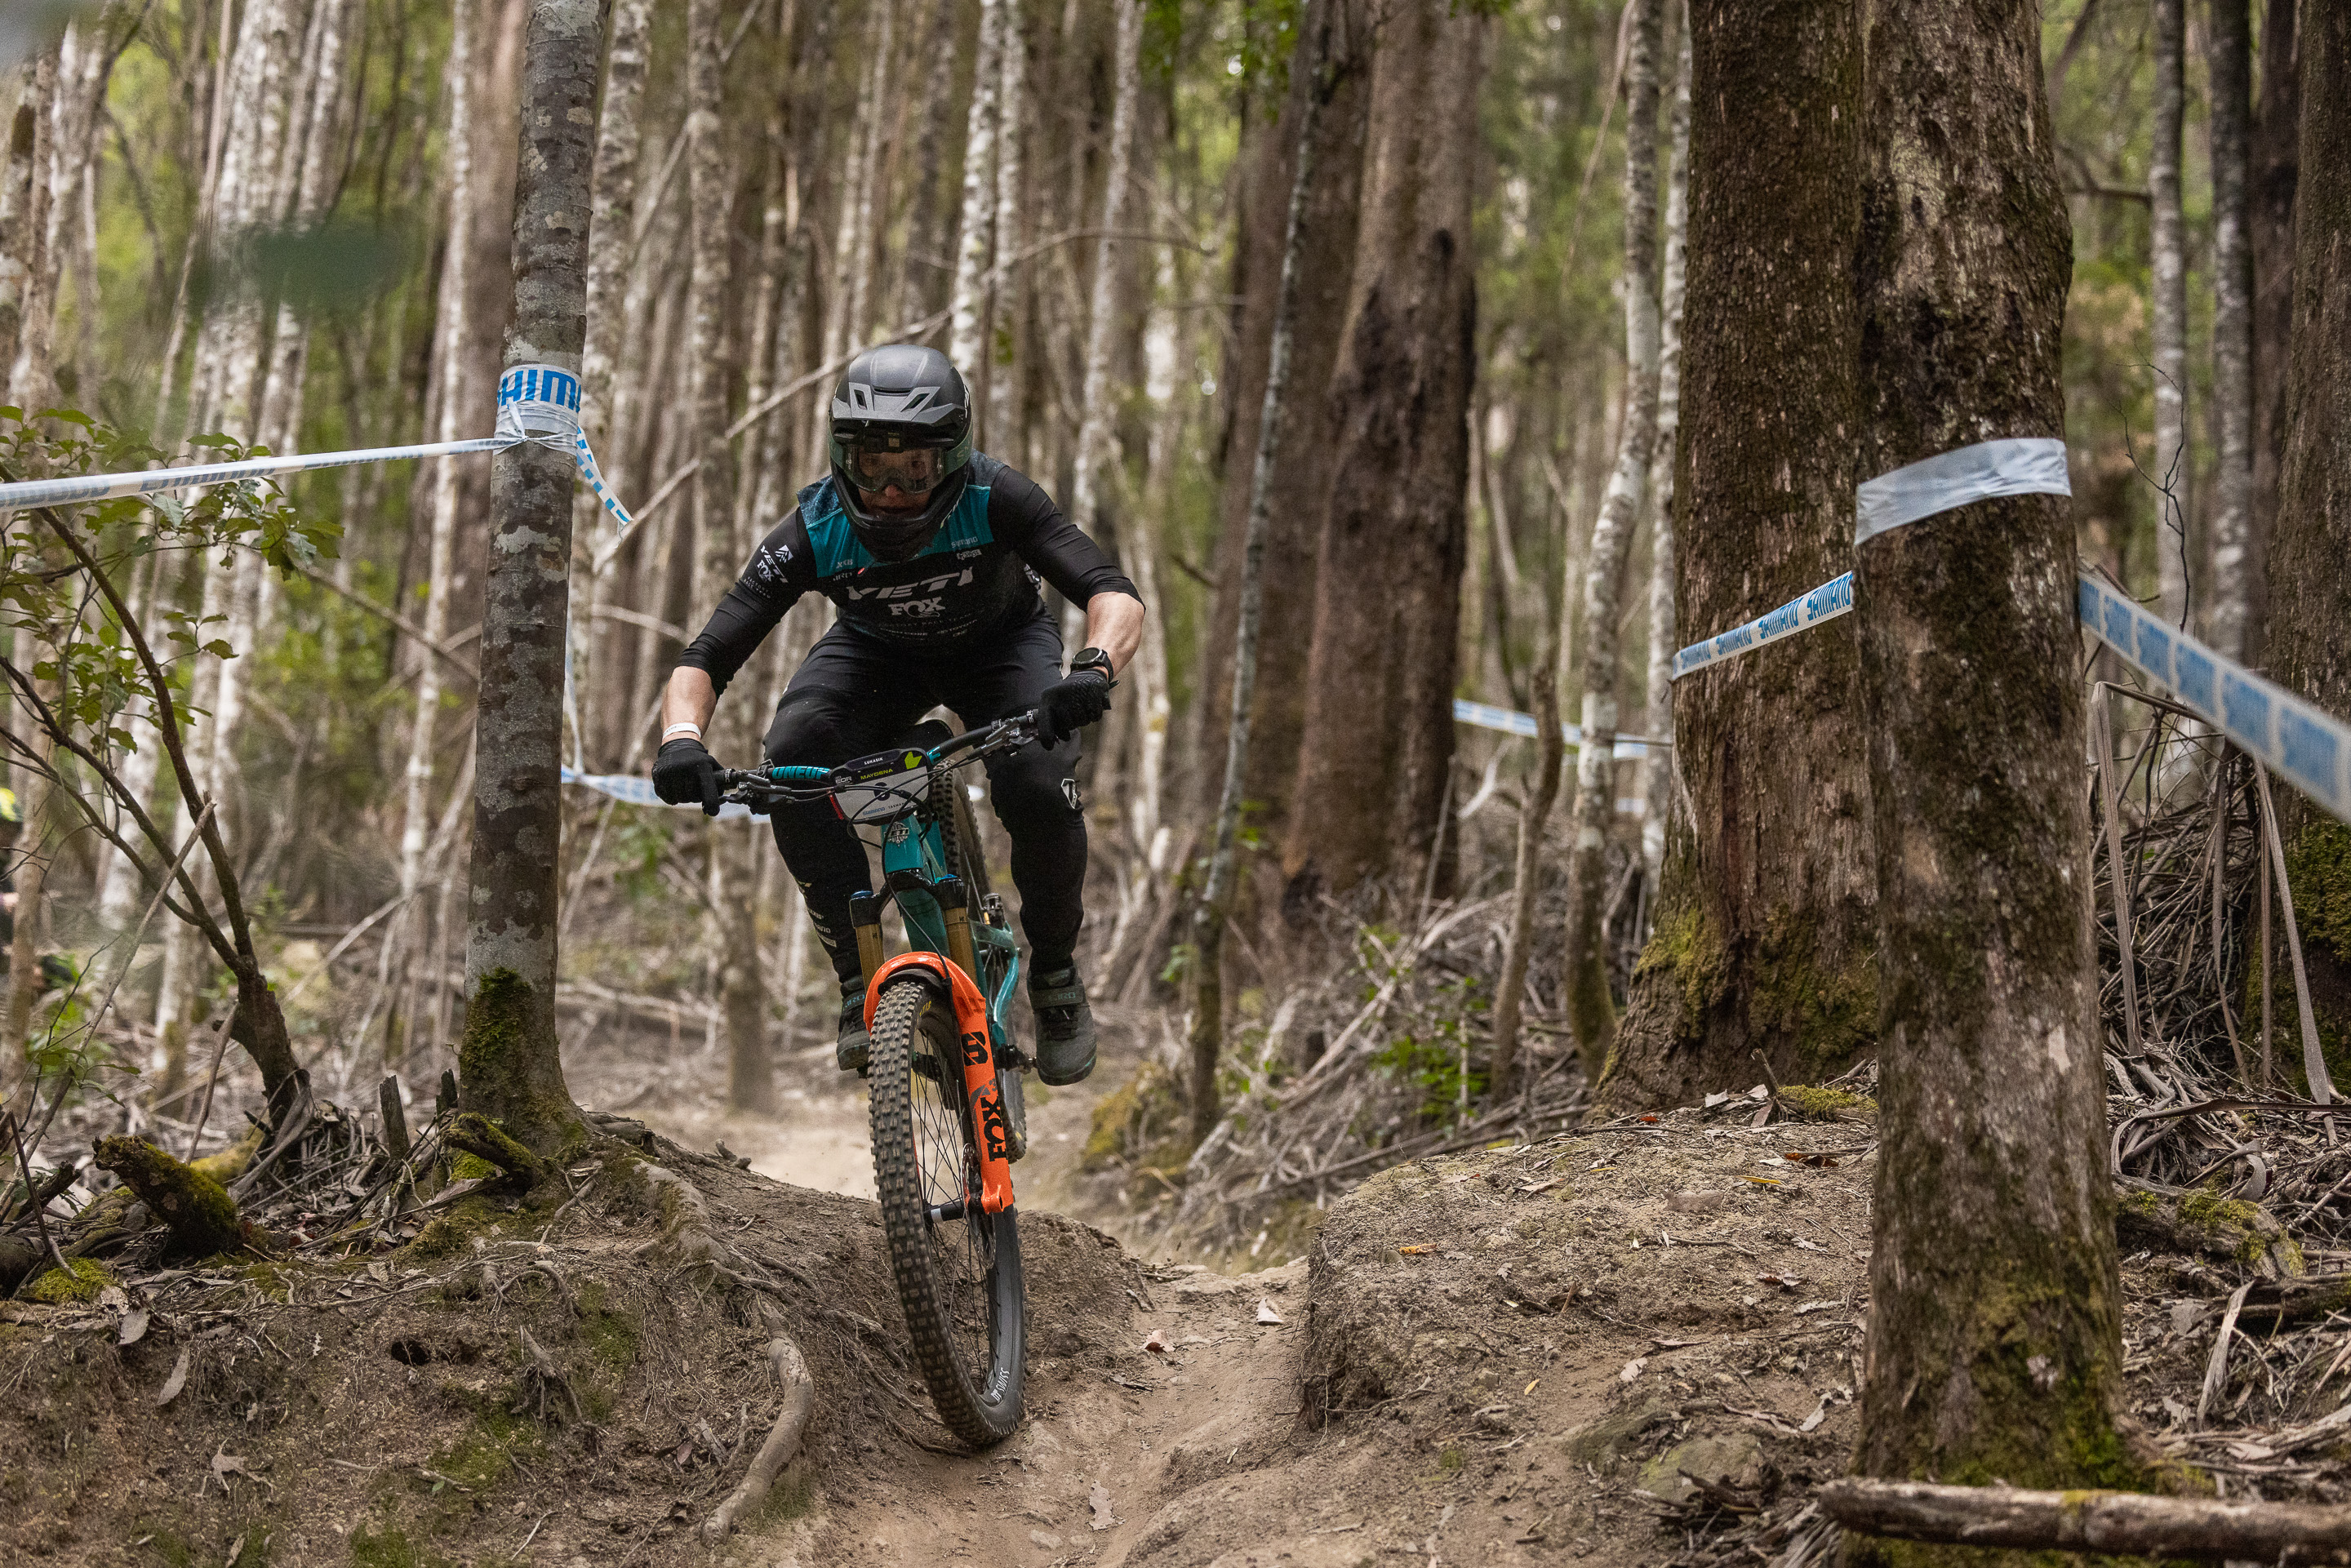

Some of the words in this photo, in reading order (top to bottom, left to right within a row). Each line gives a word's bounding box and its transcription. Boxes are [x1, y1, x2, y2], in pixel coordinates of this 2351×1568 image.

[497, 370, 581, 412] HIM
[757, 559, 775, 582] FOX
[846, 566, 973, 601] YETI
[888, 596, 946, 619] FOX
[1758, 597, 1804, 640] SHIMANO
[1807, 573, 1853, 620] SHIMANO
[864, 757, 883, 765] LUKASIK
[860, 768, 893, 780] MAYDENA
[863, 806, 886, 816] SHIMANO
[980, 1096, 1008, 1162] FOX
[996, 1366, 1010, 1393] SWISS
